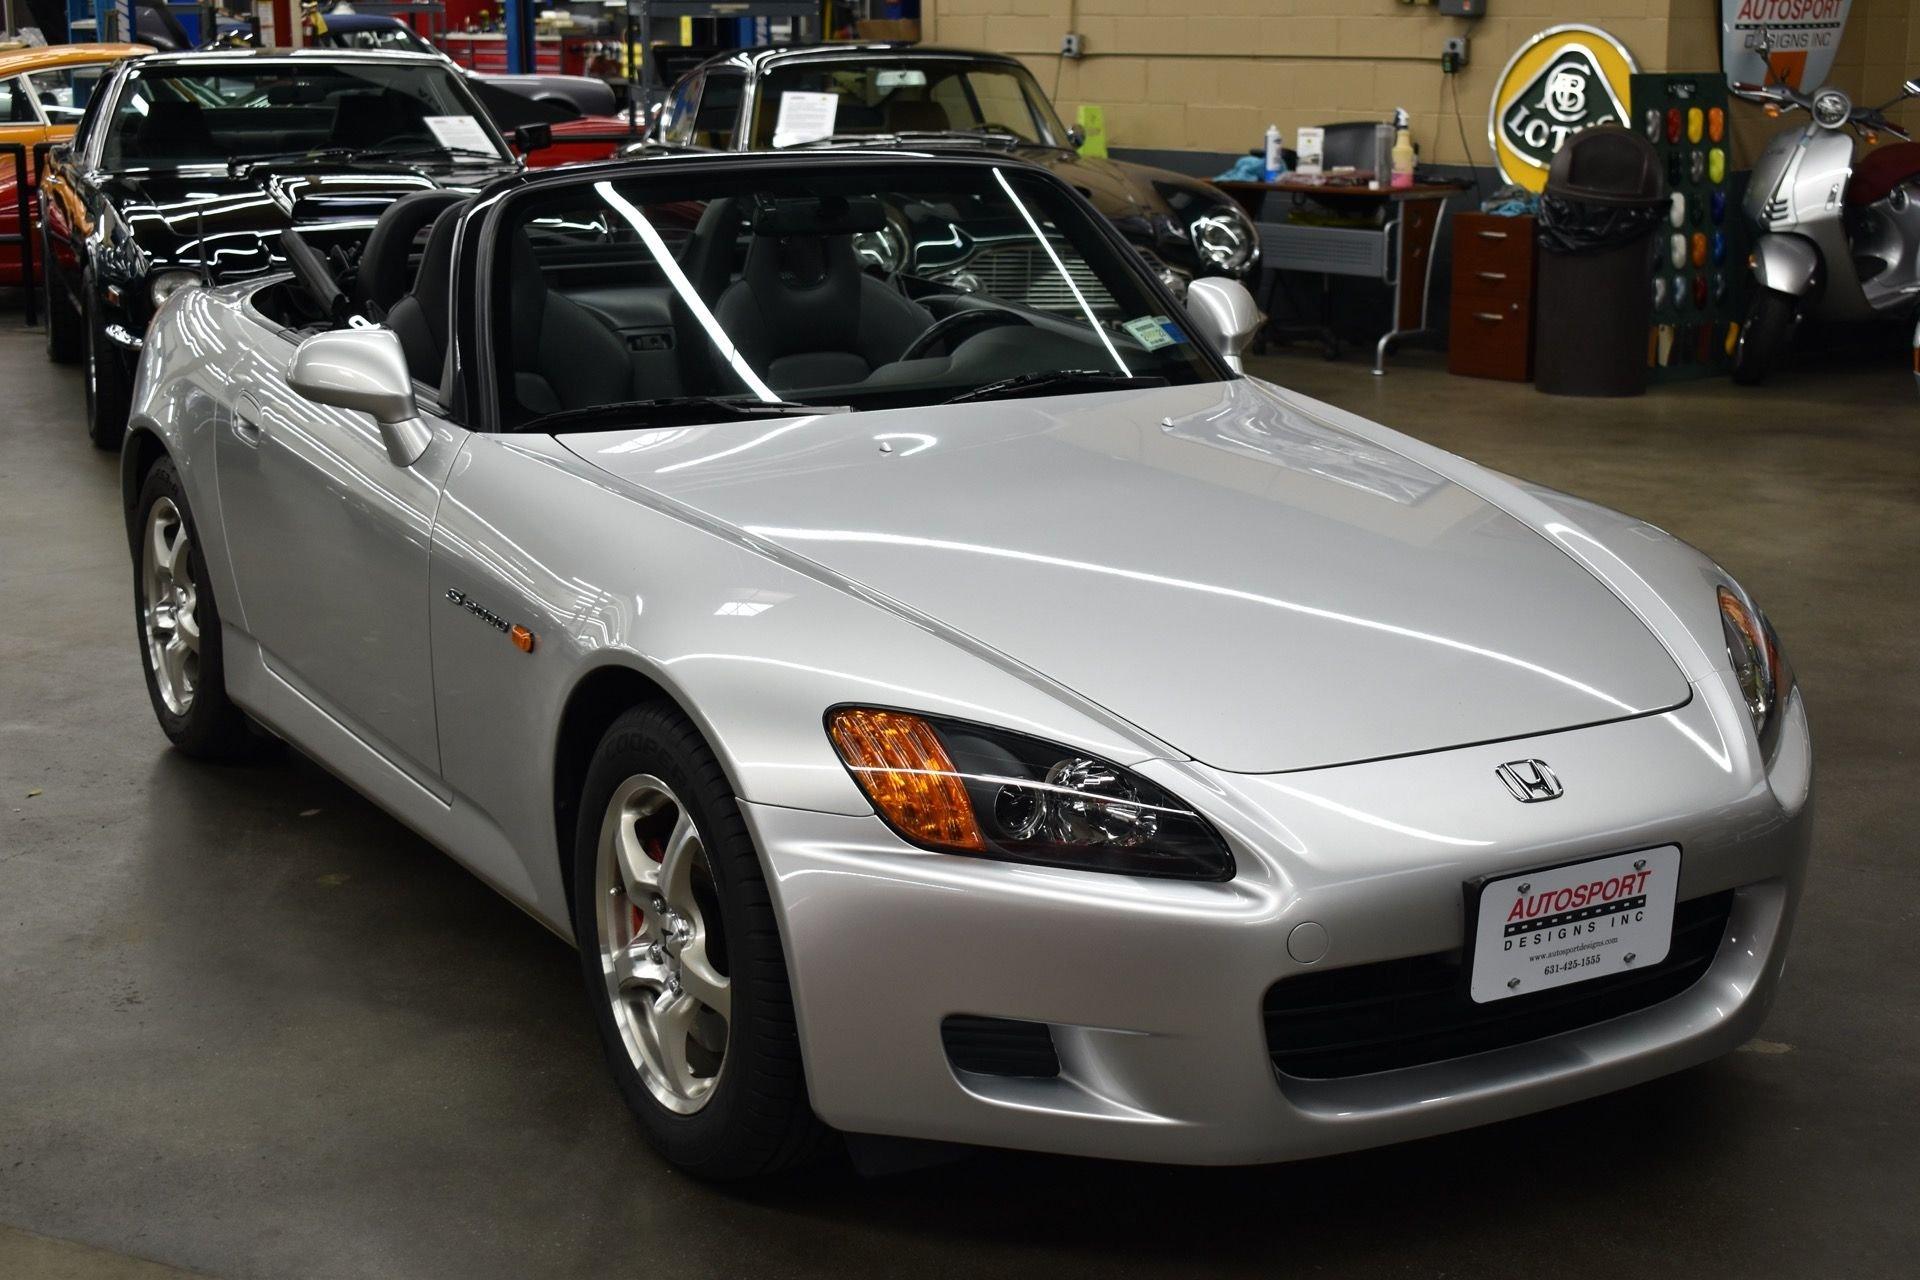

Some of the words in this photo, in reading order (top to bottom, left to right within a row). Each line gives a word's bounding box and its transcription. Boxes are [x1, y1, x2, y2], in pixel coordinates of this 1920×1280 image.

[1737, 0, 1842, 20] AUTOSPORT
[1744, 32, 1809, 48] DSIGNS
[1811, 32, 1832, 47] INC
[1508, 105, 1615, 153] LOT
[1507, 870, 1652, 922] AUTOSPORT
[1504, 921, 1596, 951] DESIGNS
[1611, 911, 1643, 927] INC
[1529, 937, 1618, 962] www.autosportdesigns.com
[1544, 954, 1601, 976] 631-425-1555
